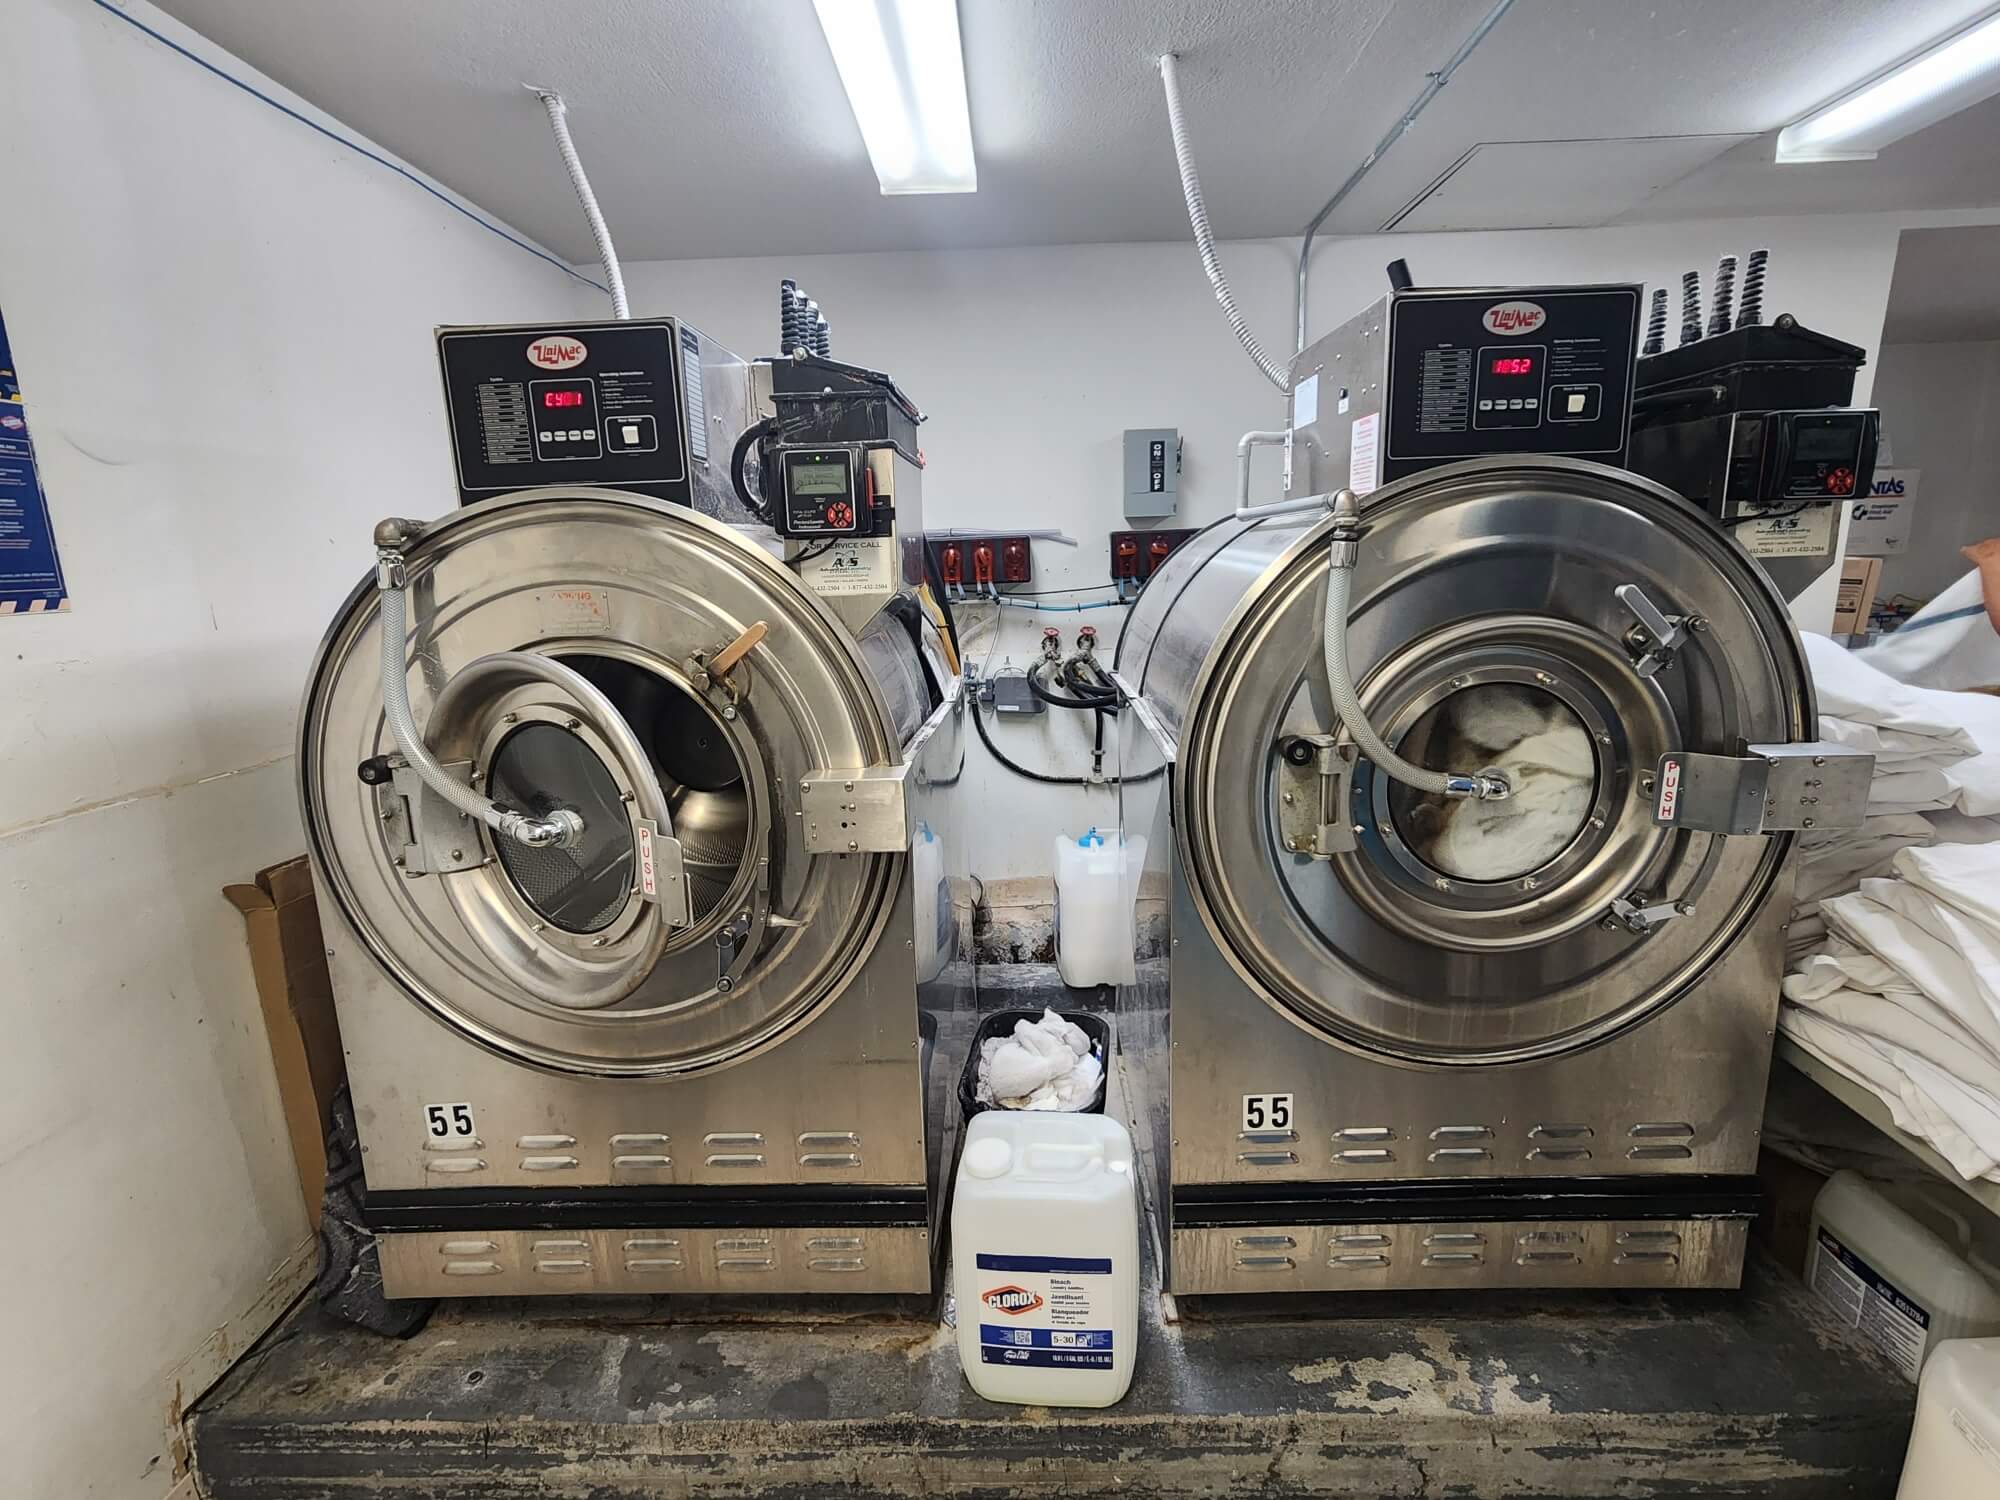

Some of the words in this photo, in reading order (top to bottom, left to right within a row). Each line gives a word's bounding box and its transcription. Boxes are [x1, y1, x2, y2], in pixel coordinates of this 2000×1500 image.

[1490, 309, 1542, 330] UniMac
[533, 344, 582, 364] UniMac
[1871, 477, 1904, 494] NTAS
[1662, 762, 1678, 816] PUSH
[641, 829, 653, 891] PUSH
[428, 1105, 472, 1136] 55
[1247, 1097, 1289, 1128] 55
[988, 1291, 1037, 1308] CLOROX
